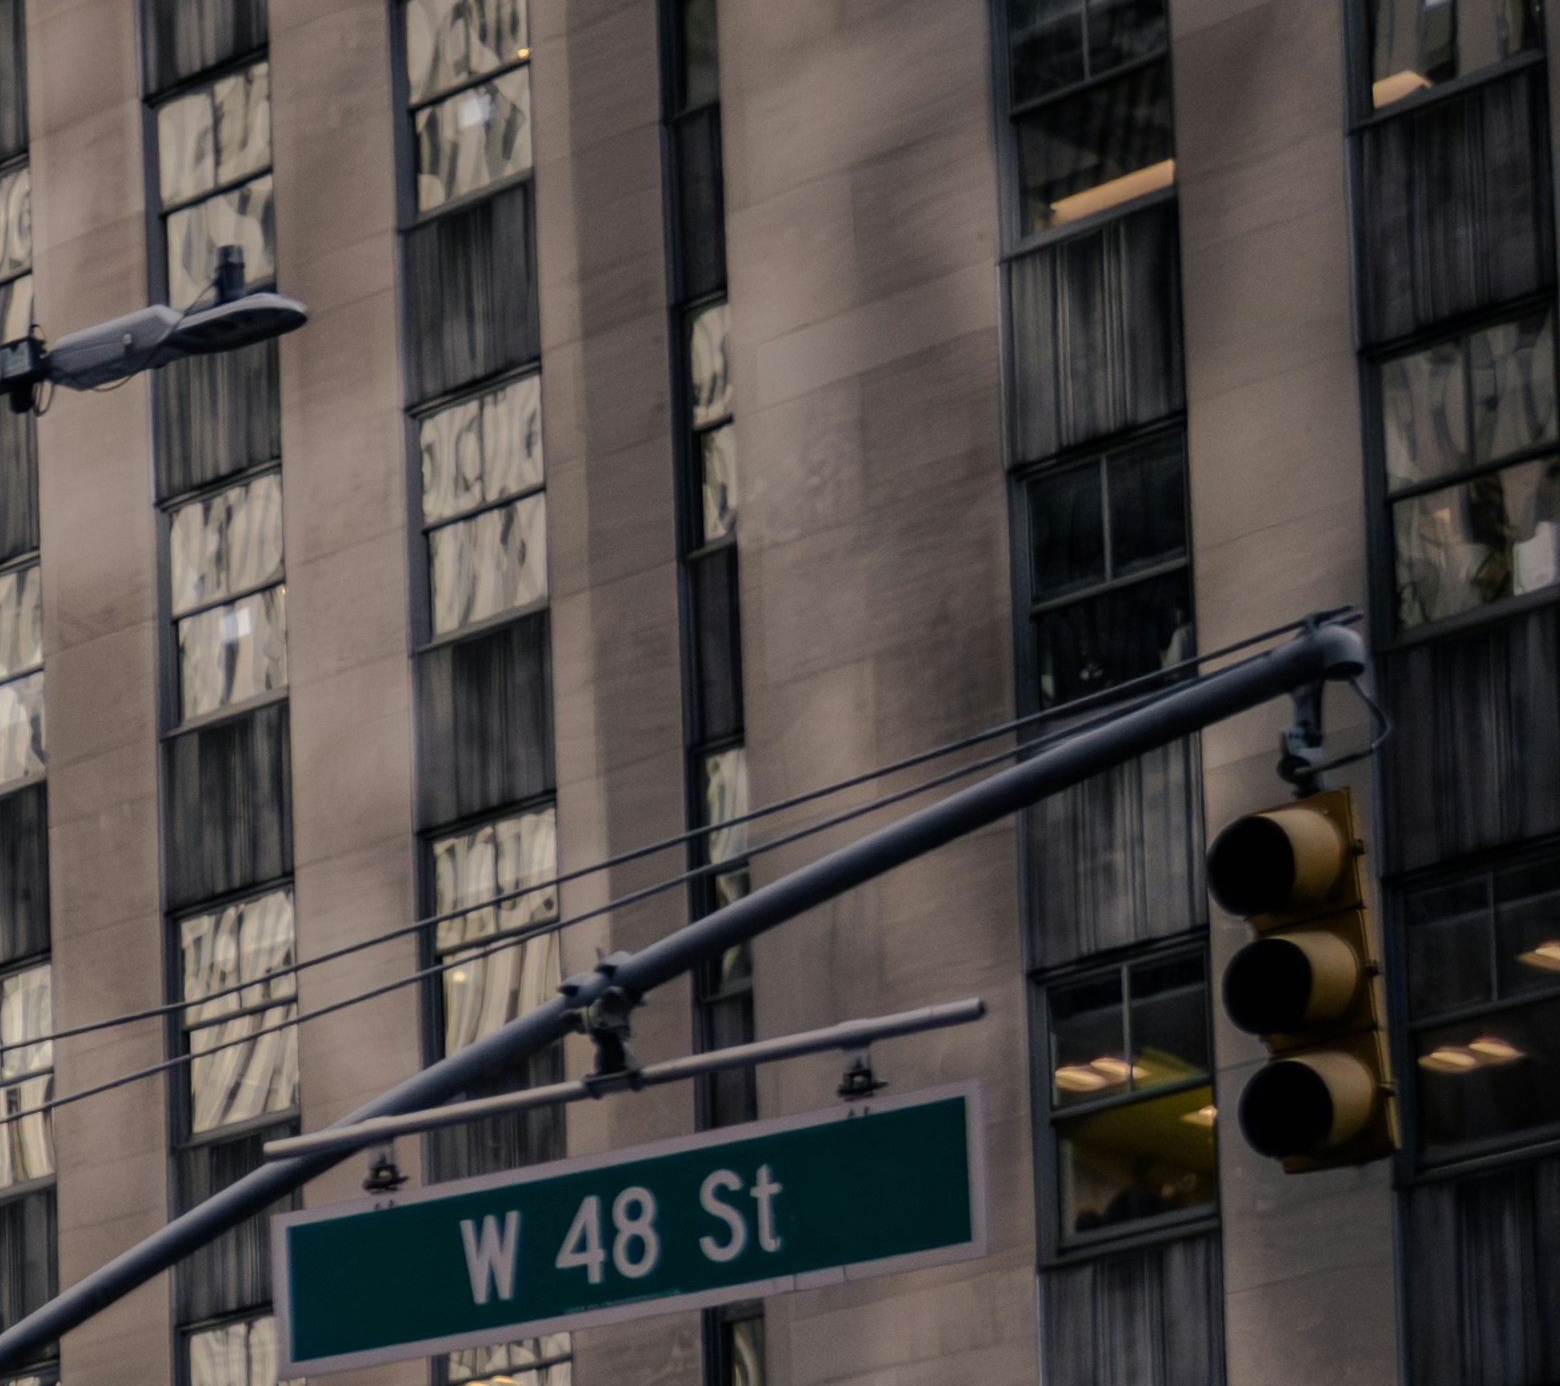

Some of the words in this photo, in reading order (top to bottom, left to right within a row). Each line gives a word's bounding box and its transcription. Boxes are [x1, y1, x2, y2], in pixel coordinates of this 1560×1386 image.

[460, 1210, 522, 1305] W
[555, 1186, 659, 1284] 48
[699, 1163, 783, 1263] St
